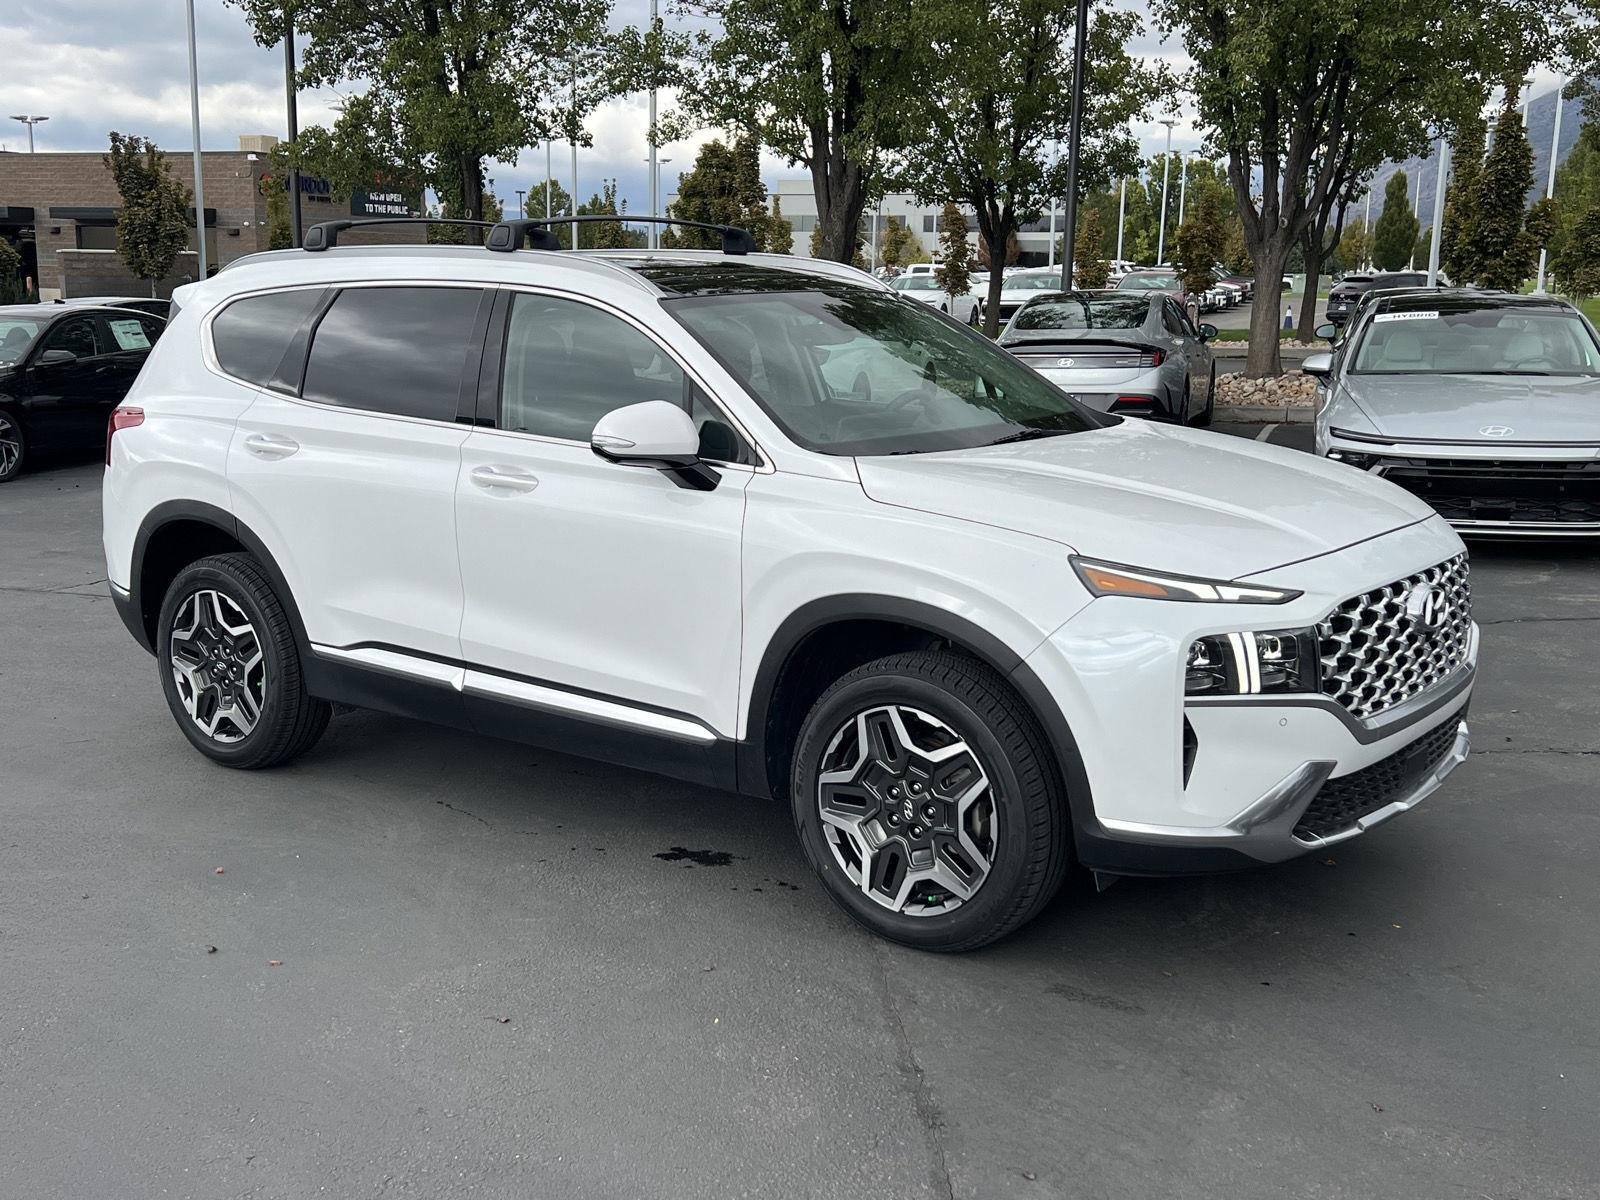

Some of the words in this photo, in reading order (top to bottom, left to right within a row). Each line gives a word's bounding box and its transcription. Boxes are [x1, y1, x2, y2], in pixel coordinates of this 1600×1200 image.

[369, 192, 385, 201] NOW
[386, 193, 402, 202] OPEN
[364, 203, 374, 212] TO
[374, 204, 386, 213] THE
[387, 204, 408, 214] PUBLIC
